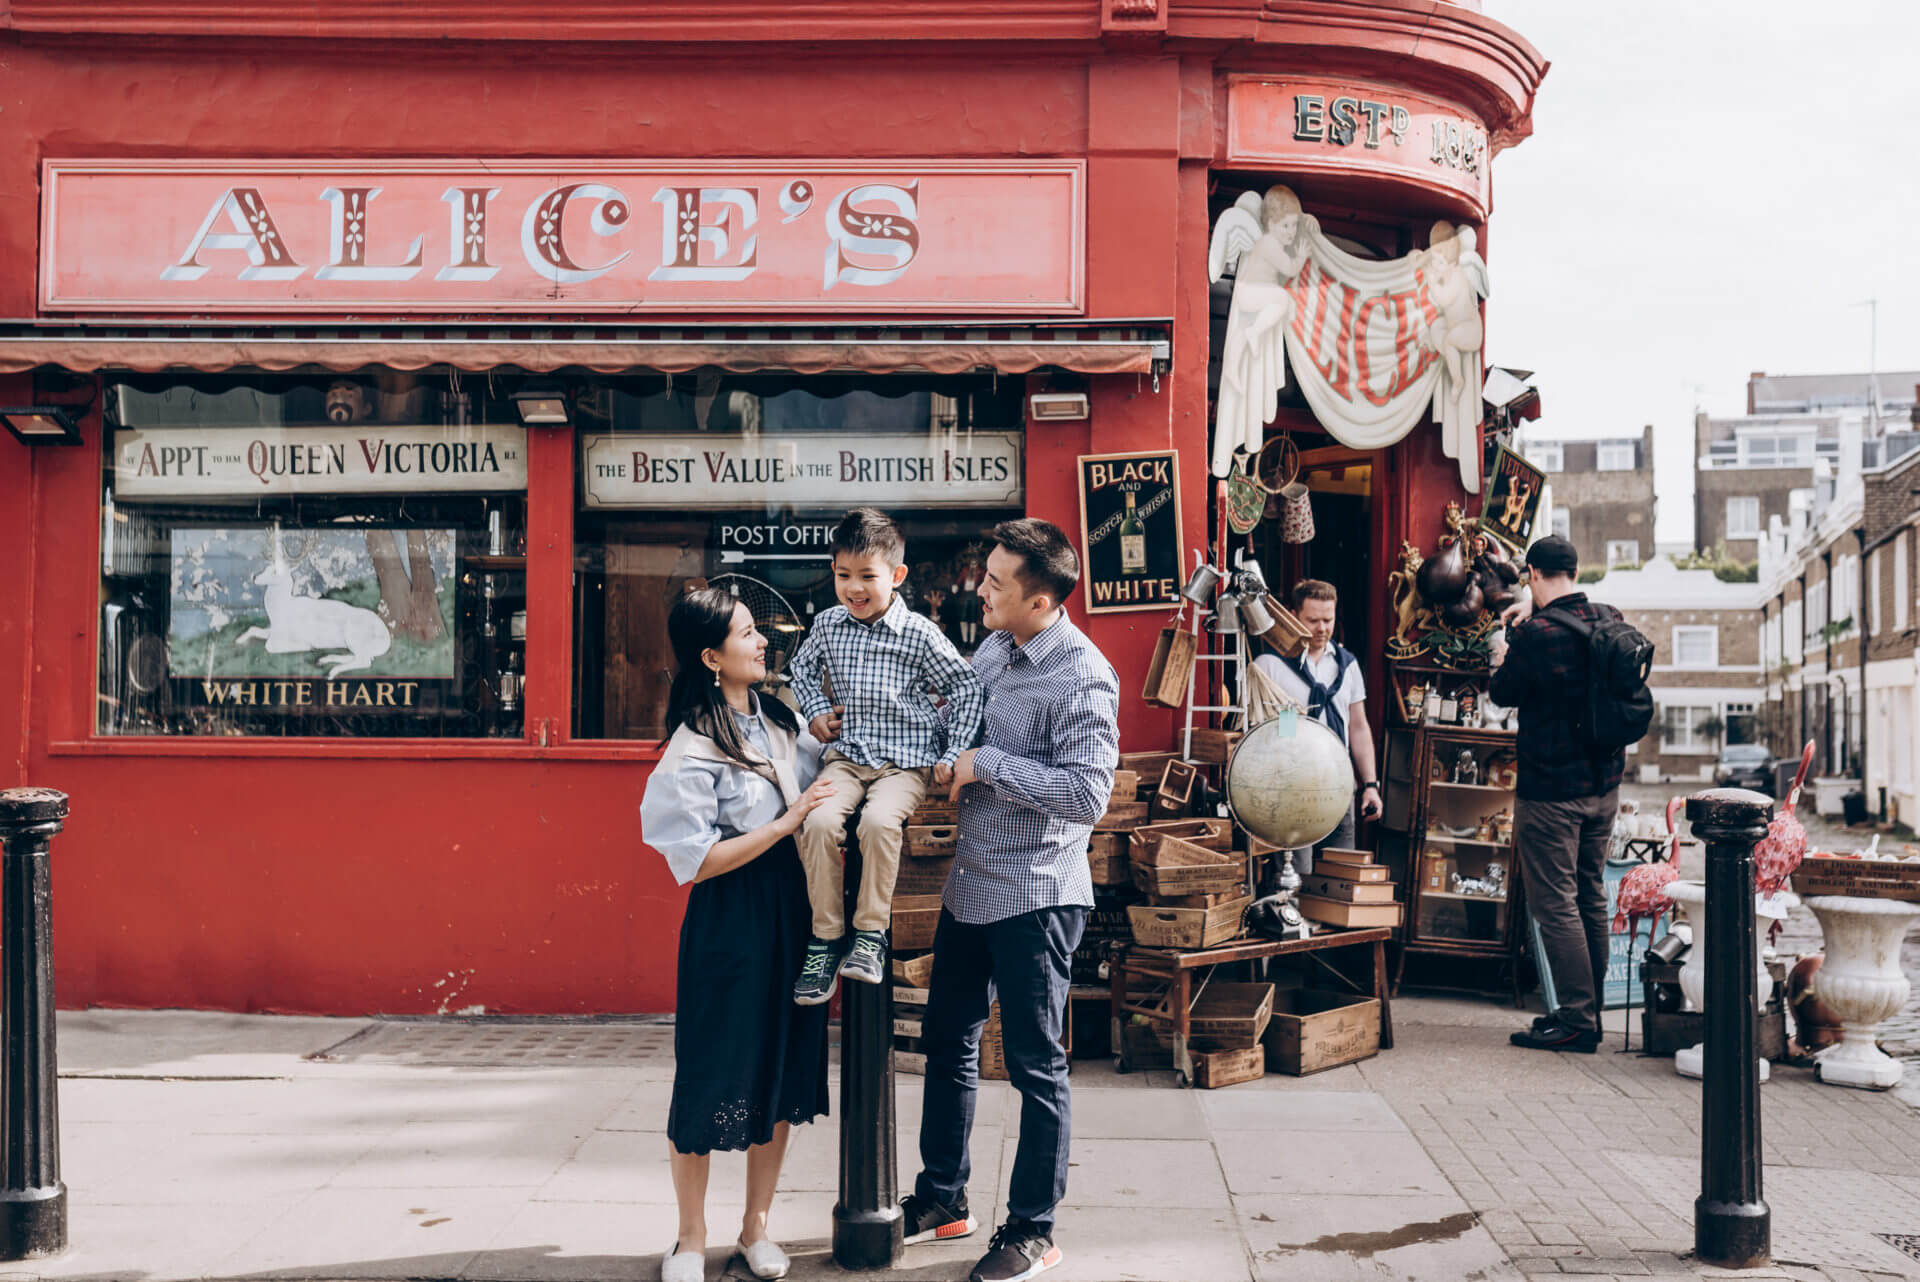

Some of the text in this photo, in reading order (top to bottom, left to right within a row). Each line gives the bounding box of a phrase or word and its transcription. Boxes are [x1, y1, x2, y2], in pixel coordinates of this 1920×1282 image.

[160, 178, 920, 291] ALICE'S
[137, 442, 211, 477] APPT.
[248, 440, 345, 484] QUEEN
[358, 439, 500, 474] VICTORIA
[596, 449, 1008, 483] THE BEST VALUE IN THE BRITISH ISLES
[1091, 461, 1169, 491] BLACK
[1118, 482, 1141, 492] AND
[1089, 488, 1172, 545] SCOTCH WHISKY
[721, 525, 840, 545] POST OFFIC
[1094, 578, 1175, 601] WHITE
[203, 682, 418, 706] WHITE HART
